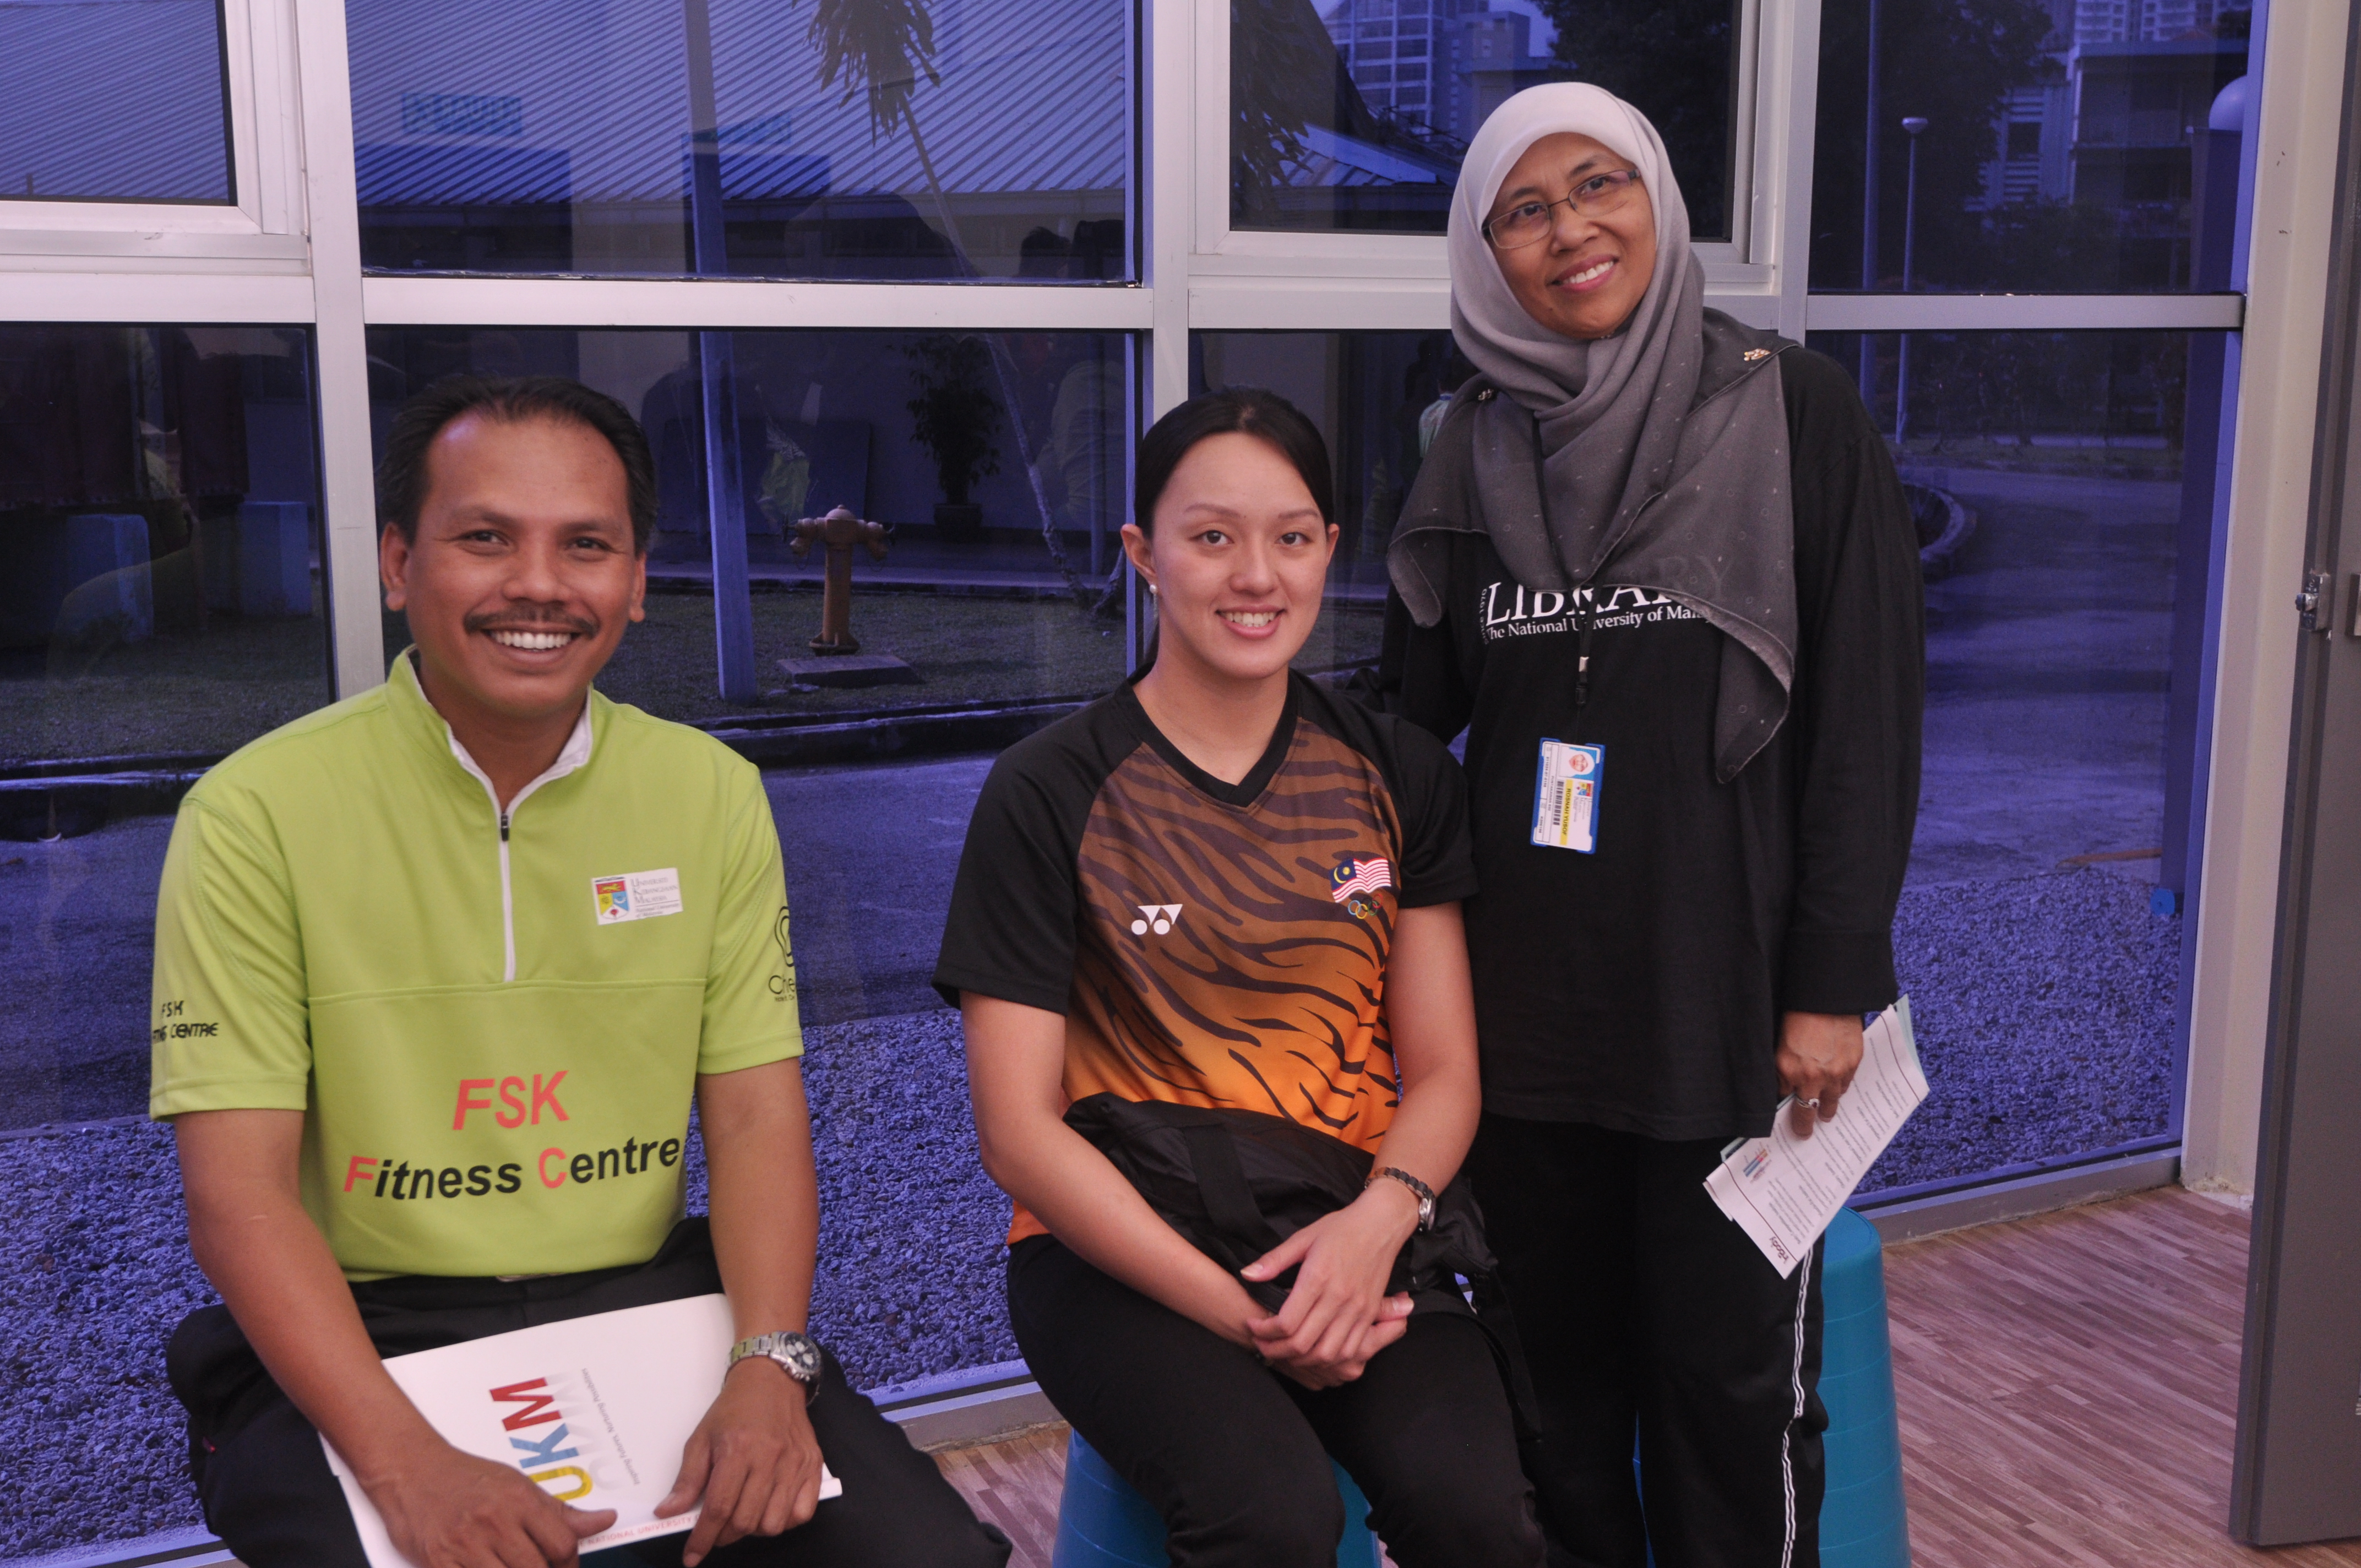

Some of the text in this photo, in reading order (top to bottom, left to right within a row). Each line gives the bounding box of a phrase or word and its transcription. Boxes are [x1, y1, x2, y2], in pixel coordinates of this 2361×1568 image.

[1508, 618, 1568, 636] National
[1571, 611, 1644, 631] Uiversity
[1647, 606, 1663, 622] of
[452, 1070, 570, 1130] FSK
[343, 1136, 680, 1200] Fitness Centre
[1769, 1236, 1789, 1264] InBody
[597, 1402, 615, 1434] Nurturing
[489, 1377, 594, 1503] UKM
[623, 1458, 640, 1486] Inspiring
[588, 1530, 634, 1545] NATIONAL
[637, 1518, 692, 1533] UNIVERSITY
